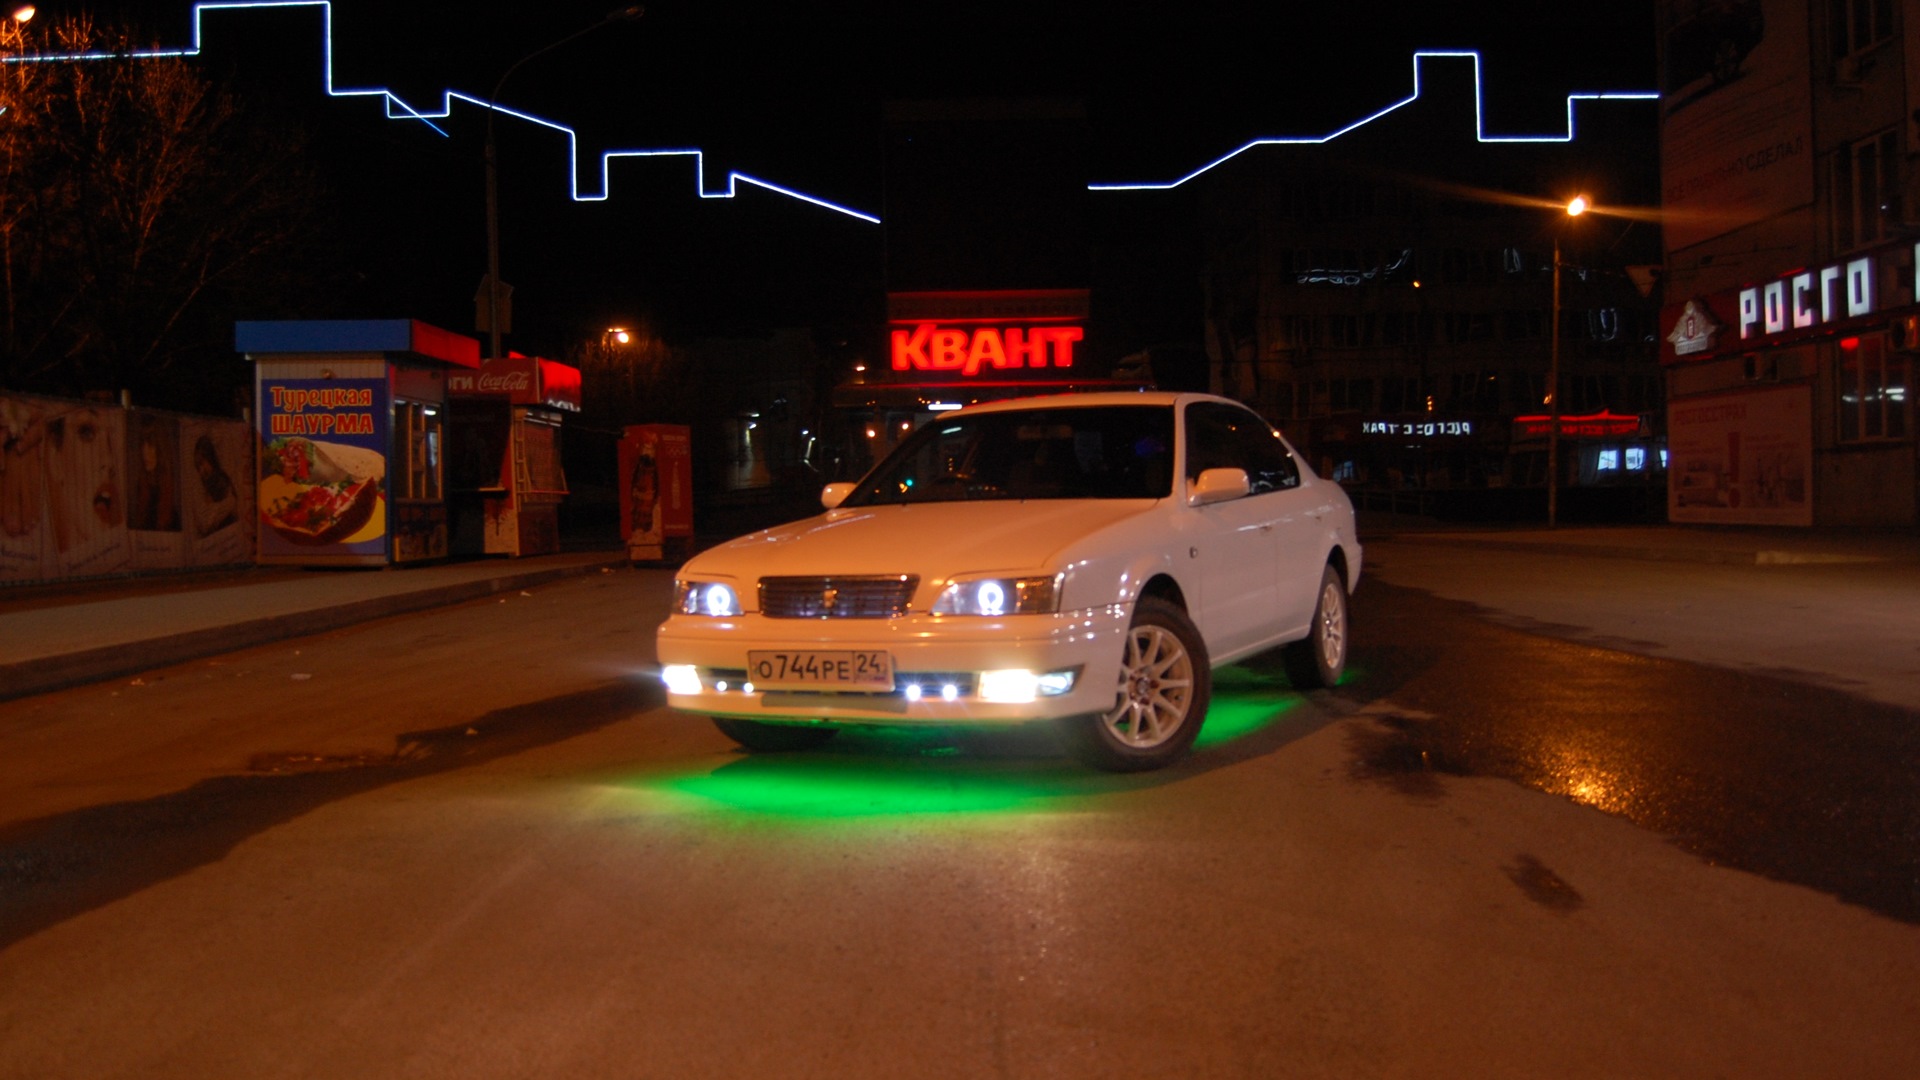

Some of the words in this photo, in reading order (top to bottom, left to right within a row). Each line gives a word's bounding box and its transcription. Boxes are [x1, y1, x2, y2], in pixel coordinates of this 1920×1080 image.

[890, 324, 1085, 377] КВАНТ
[270, 386, 372, 412] Турецкая
[271, 413, 374, 434] ШАУРМА
[856, 653, 881, 673] 24
